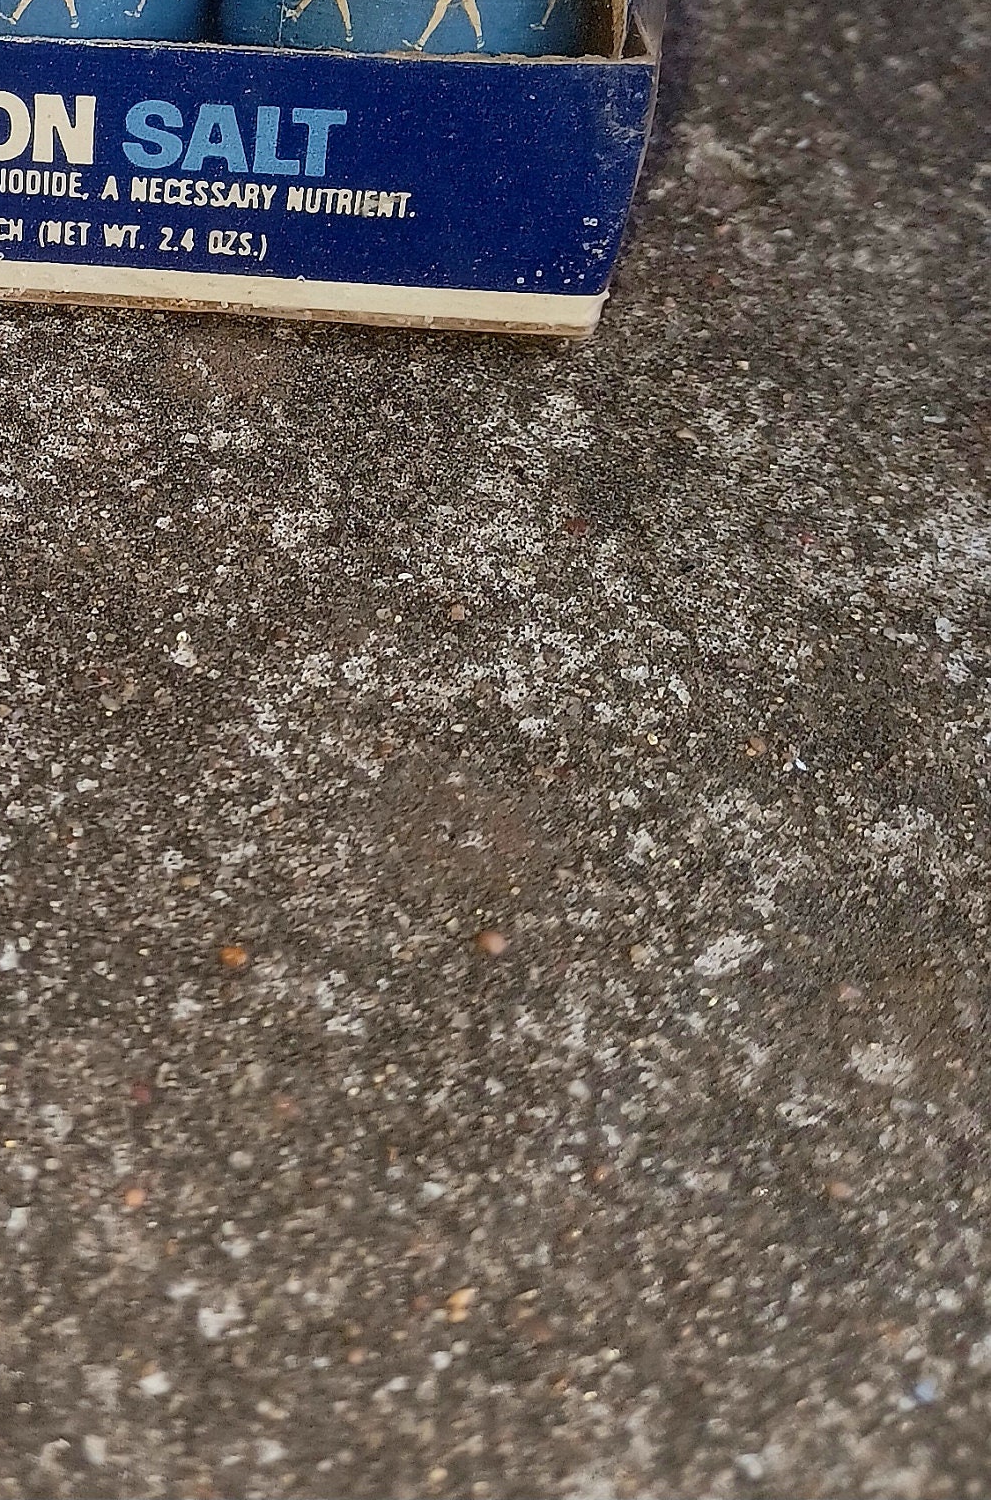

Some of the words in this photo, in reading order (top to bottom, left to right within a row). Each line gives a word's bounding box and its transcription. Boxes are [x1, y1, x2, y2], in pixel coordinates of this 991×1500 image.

[122, 99, 348, 176] SALT
[0, 167, 89, 200] IODIDE,
[101, 175, 119, 201] A
[130, 177, 278, 210] NECESSARY
[286, 187, 417, 218] NUTRIENT.
[38, 220, 92, 248] (NET
[103, 223, 146, 250] WT.
[158, 227, 195, 252] 2.4
[208, 230, 269, 261] OZS.)
